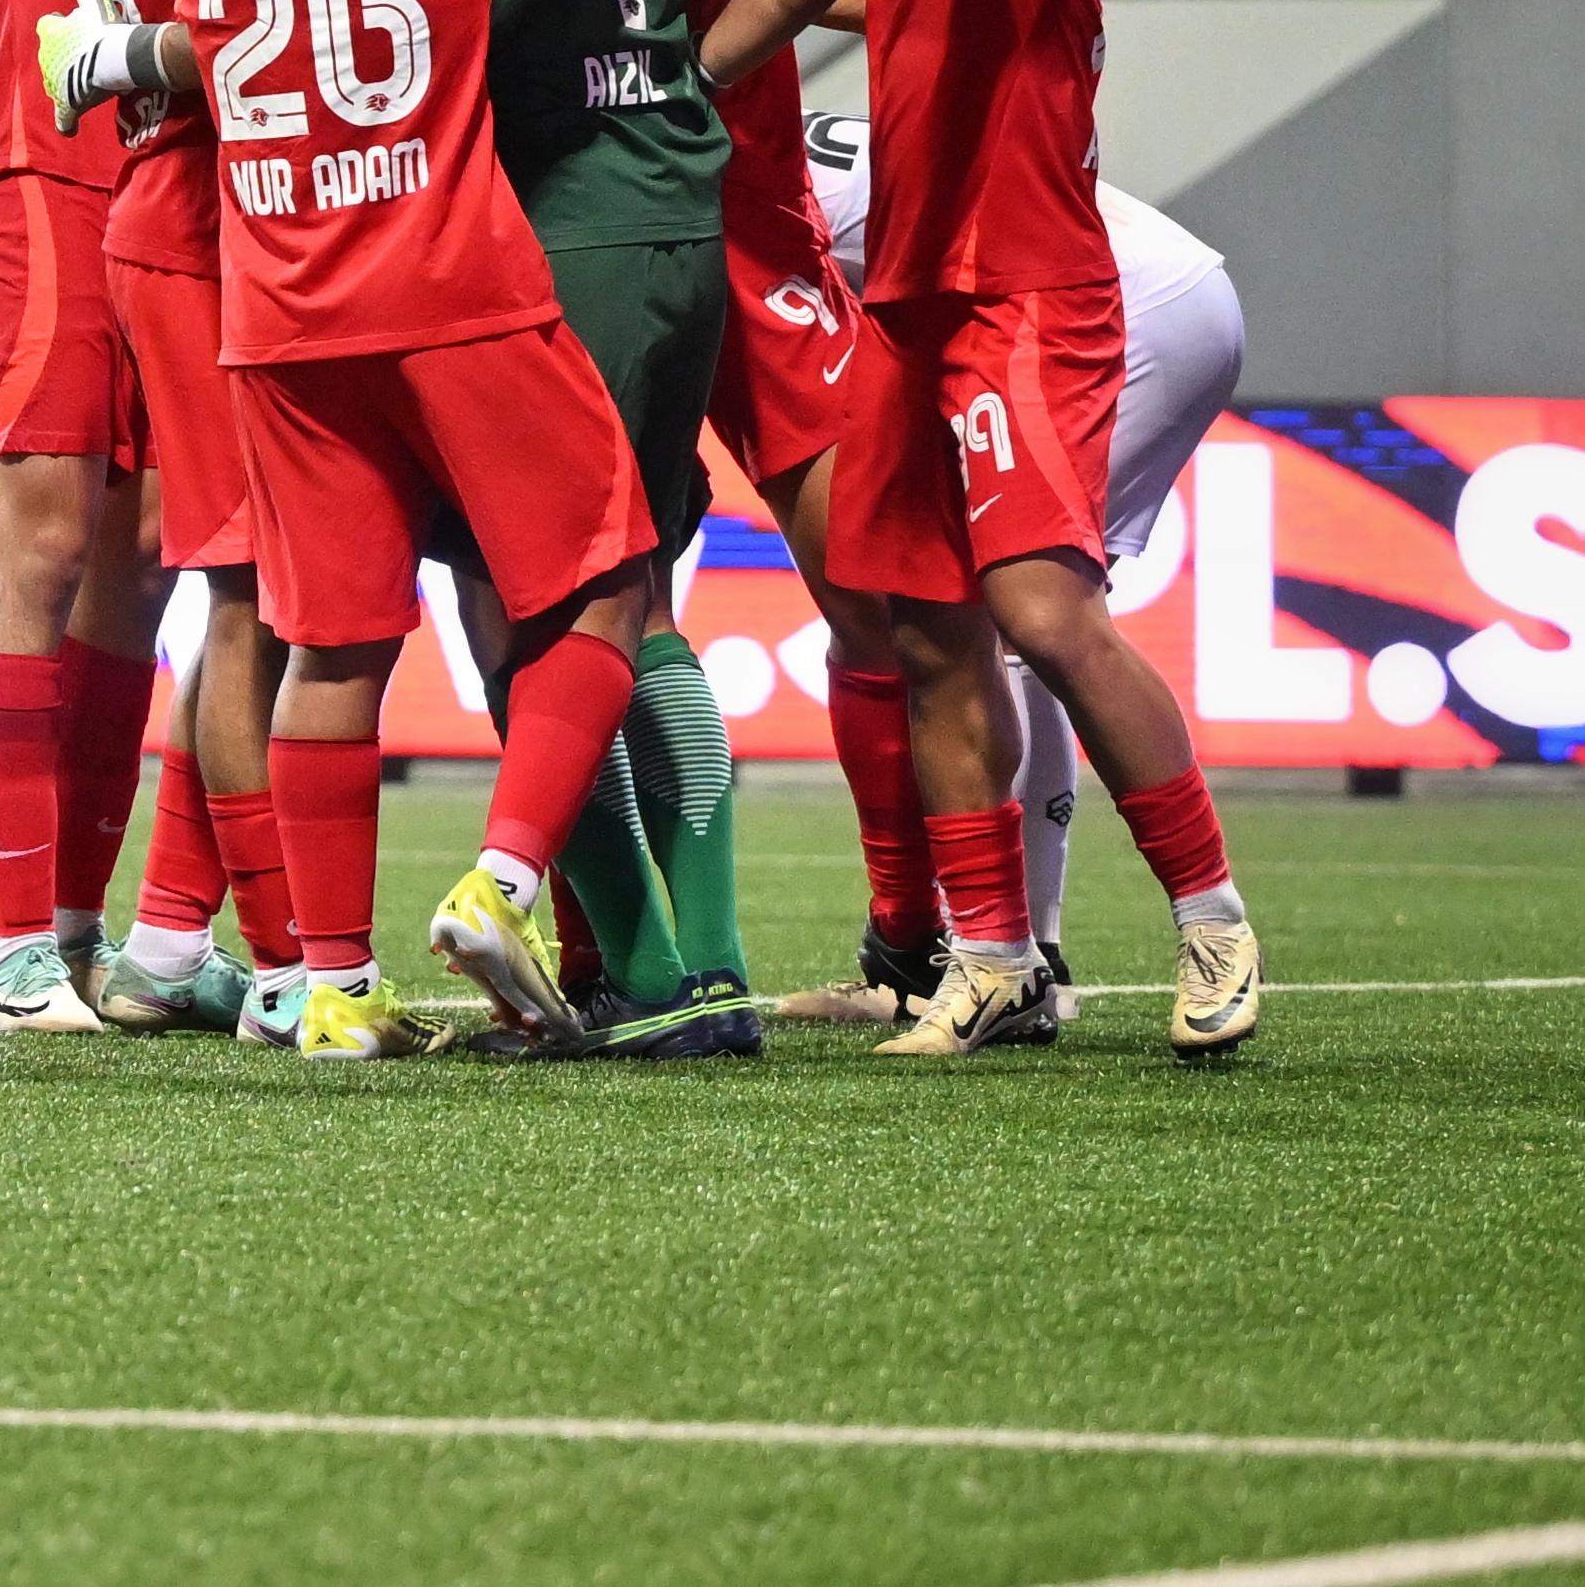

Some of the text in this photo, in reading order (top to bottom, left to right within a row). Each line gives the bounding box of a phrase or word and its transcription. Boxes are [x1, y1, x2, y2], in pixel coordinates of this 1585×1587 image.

[584, 49, 668, 108] AIZIL
[229, 138, 428, 217] NUR ADAM
[763, 274, 840, 336] 9
